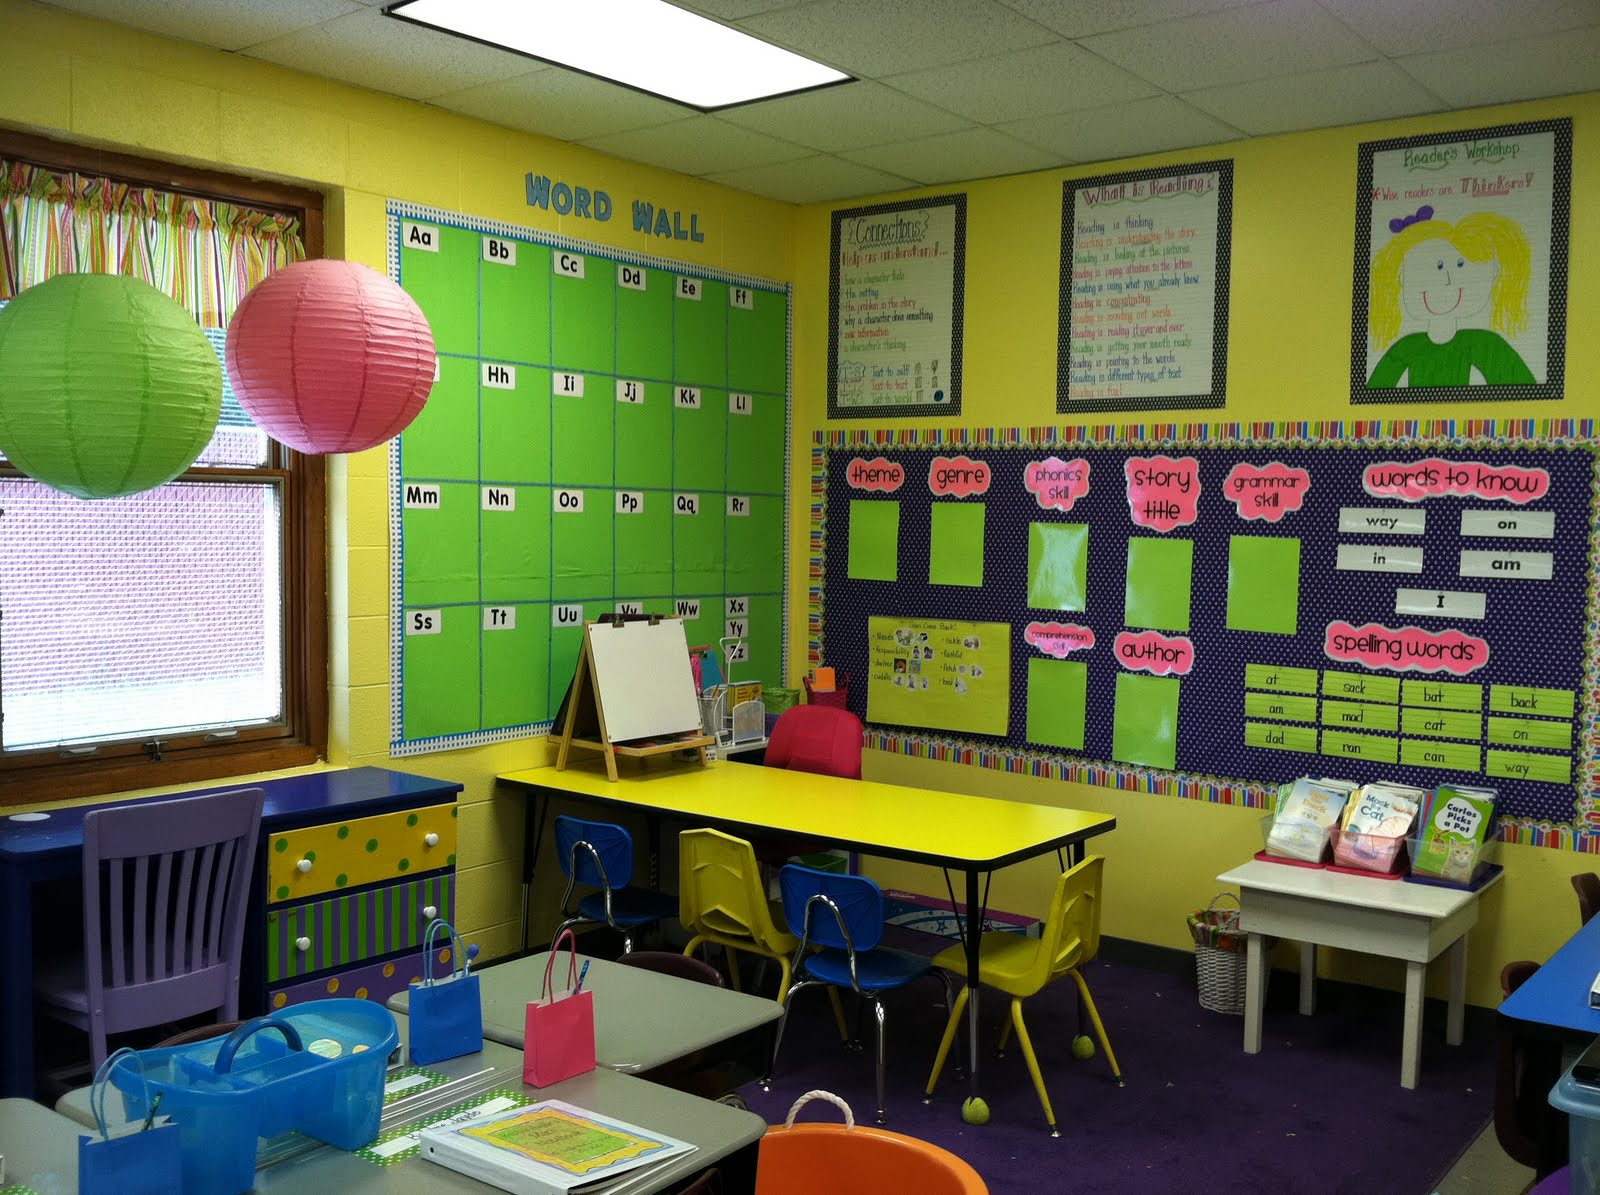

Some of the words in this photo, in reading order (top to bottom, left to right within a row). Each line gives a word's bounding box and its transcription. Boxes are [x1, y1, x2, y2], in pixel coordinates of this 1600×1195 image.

[1465, 140, 1520, 159] Workshop
[1082, 185, 1126, 206] What
[1133, 181, 1144, 197] is
[525, 172, 612, 221] WORD
[632, 200, 705, 242] WALL
[1125, 214, 1153, 228] thinking
[409, 226, 431, 246] Aa
[489, 241, 509, 259] Bb
[560, 255, 578, 272] Cc
[622, 268, 641, 286] Dd
[682, 280, 695, 295] Ee
[735, 289, 747, 304] Ff
[1126, 279, 1140, 290] what
[488, 366, 509, 384] Hh
[564, 375, 575, 392] Ii
[624, 382, 636, 402] Jj
[680, 389, 695, 404] Kk
[736, 396, 746, 410] Ll
[852, 466, 900, 483] theme
[937, 468, 984, 489] genre
[1036, 468, 1082, 482] phonics
[1134, 468, 1190, 493] story
[1372, 468, 1439, 487] words
[1445, 468, 1469, 486] to
[1477, 469, 1538, 493] know
[1234, 476, 1300, 492] grammar
[407, 486, 437, 503] Mm
[489, 489, 508, 506] Nn
[559, 492, 578, 507] Oo
[1049, 486, 1069, 499] skill
[1254, 493, 1278, 507] skill
[622, 494, 637, 512] Pp
[677, 496, 695, 514] Qq
[733, 498, 743, 512] Rr
[1143, 500, 1180, 520] title
[1366, 517, 1398, 529] way
[1498, 521, 1517, 530] on
[1373, 553, 1386, 564] in
[1491, 559, 1520, 570] am
[622, 605, 637, 614] Vv
[677, 602, 697, 616] Ww
[730, 600, 744, 612] Xx
[1437, 595, 1445, 608] I
[414, 613, 432, 630] Ss
[492, 609, 506, 625] Tt
[558, 607, 577, 622] Uu
[730, 622, 743, 637] Yy
[731, 646, 743, 659] Zz
[1122, 642, 1184, 664] author
[1333, 634, 1402, 660] spelling
[1406, 638, 1476, 661] words
[1266, 674, 1278, 685] at
[1343, 681, 1365, 695] sack
[1424, 687, 1444, 703] bat
[1511, 693, 1538, 709] back
[1269, 705, 1284, 715] am
[1342, 710, 1363, 723] mad
[1425, 719, 1445, 731] cat
[1266, 731, 1284, 744] dad
[1513, 729, 1528, 740] on
[1424, 751, 1445, 763] can
[1505, 763, 1529, 778] way
[1361, 806, 1384, 821] Cat
[1447, 803, 1477, 818] Carlos
[1447, 812, 1472, 825] Picks
